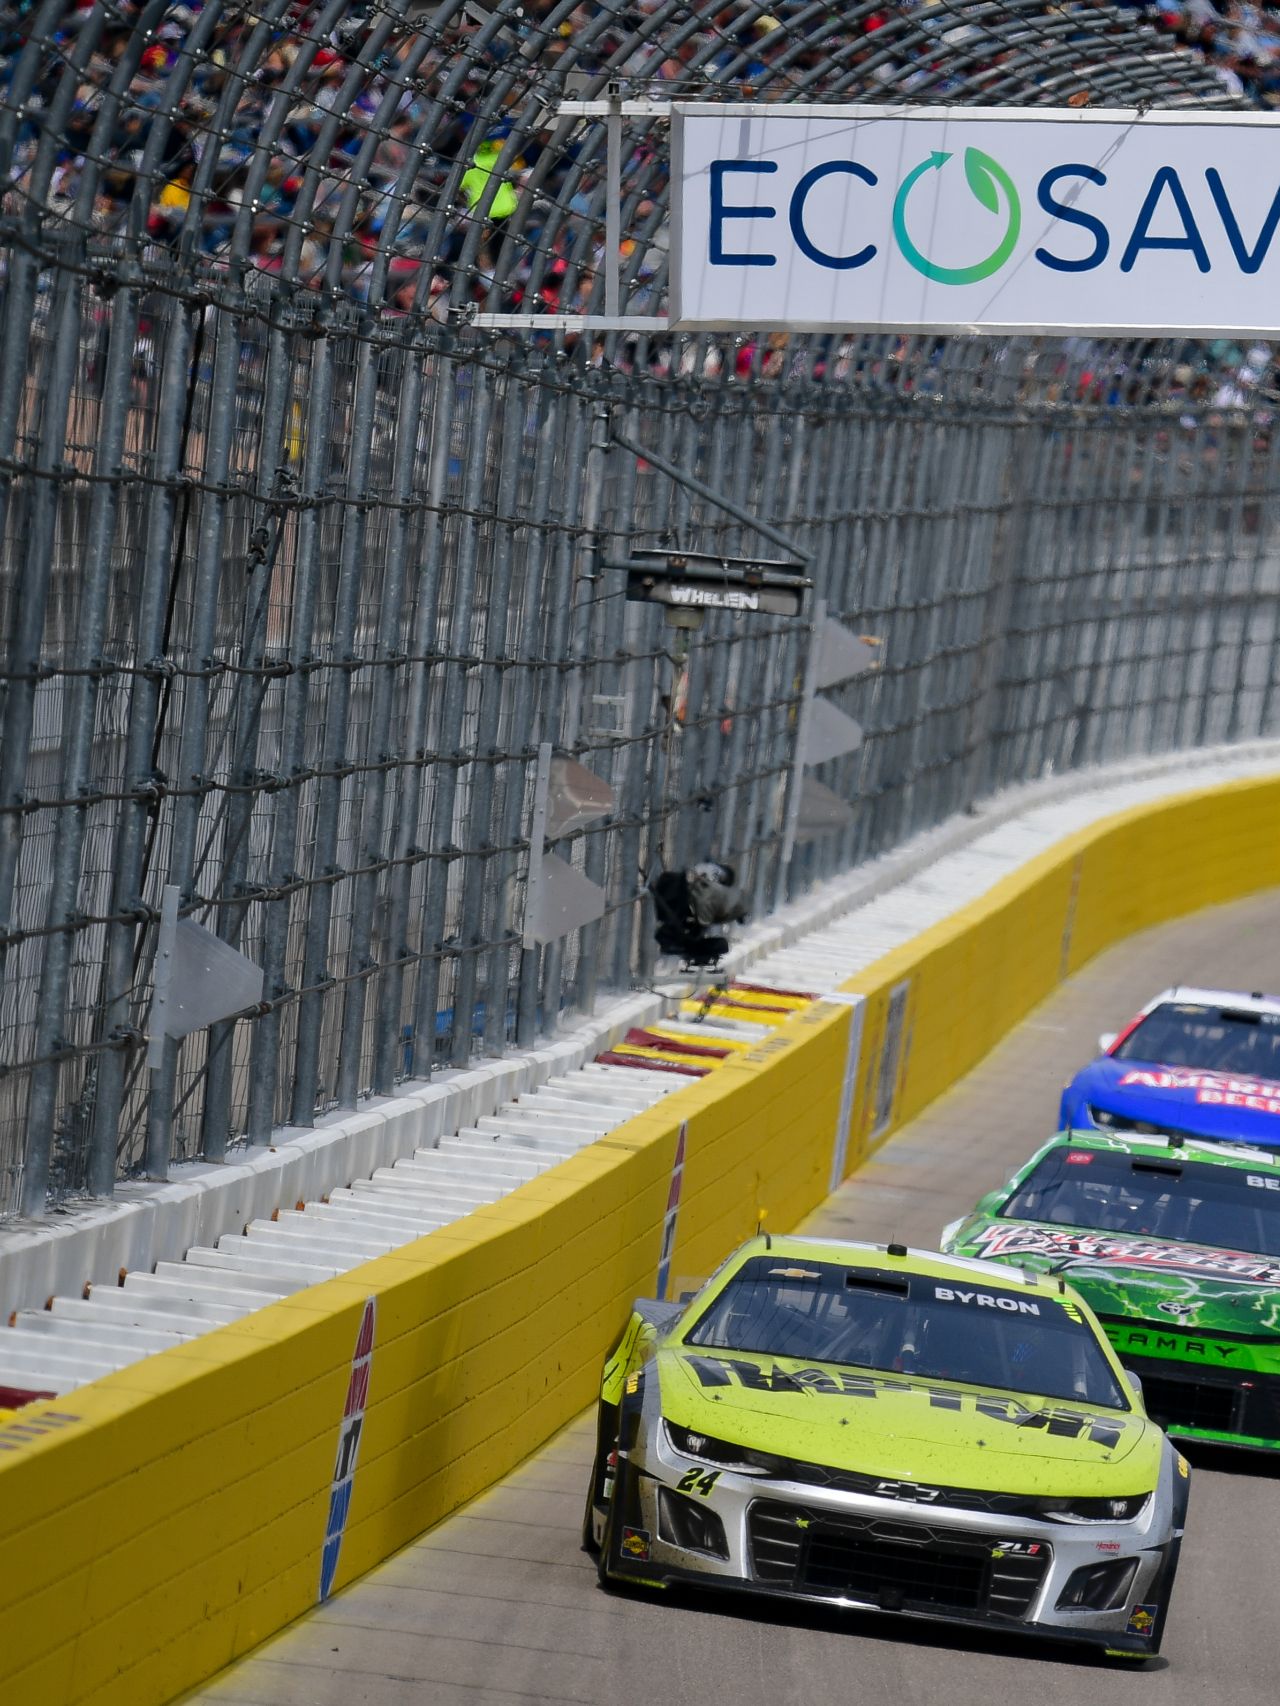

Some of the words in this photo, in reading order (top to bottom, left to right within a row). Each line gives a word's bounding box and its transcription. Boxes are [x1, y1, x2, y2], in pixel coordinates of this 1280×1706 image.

[671, 585, 759, 610] WHELEN
[934, 1287, 1041, 1316] BYRON
[675, 1467, 723, 1497] 24
